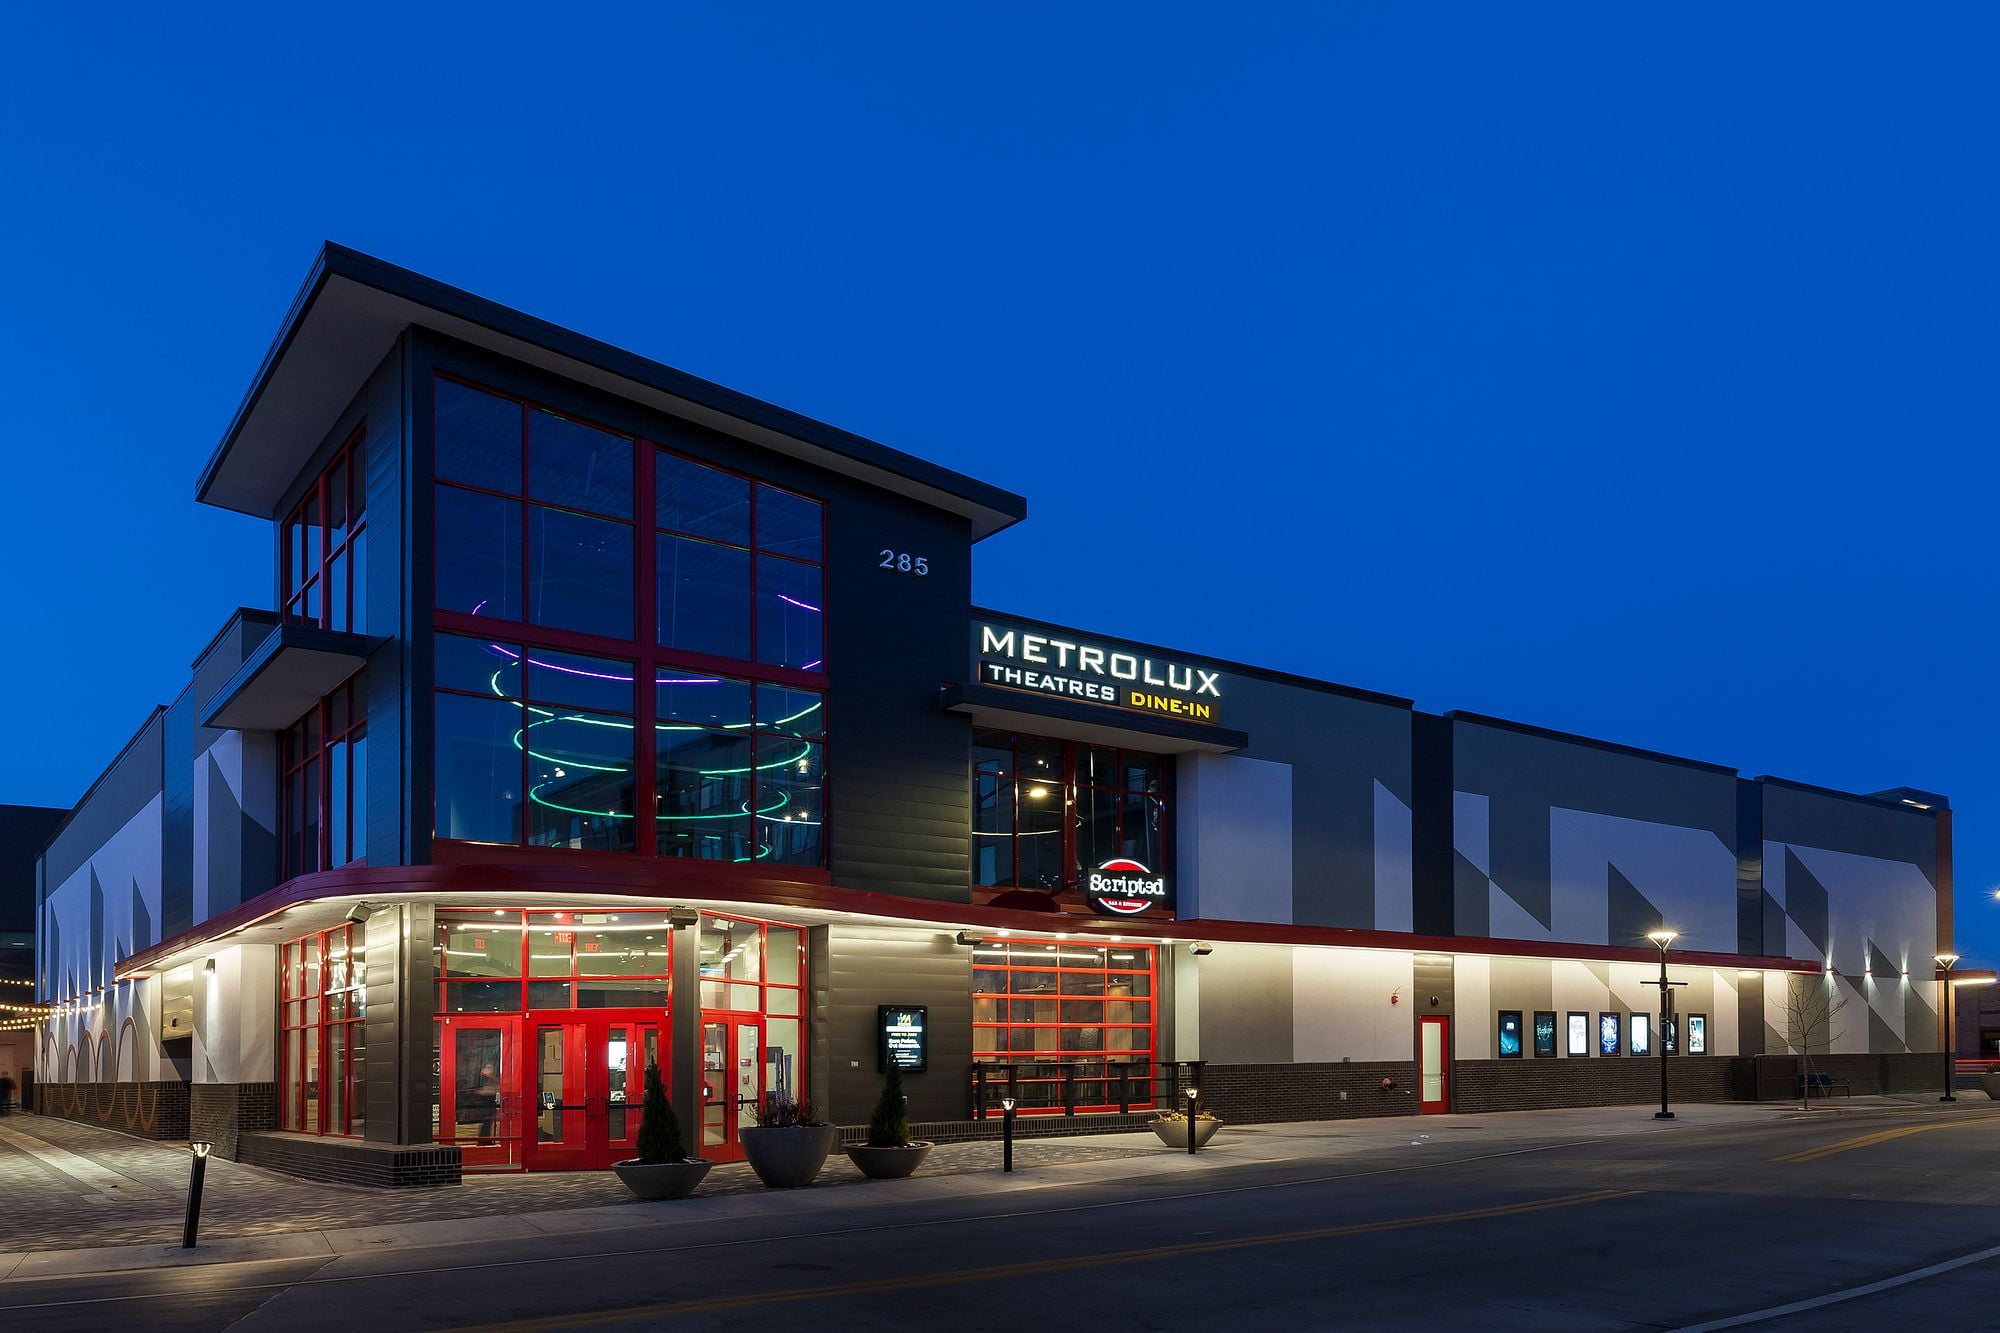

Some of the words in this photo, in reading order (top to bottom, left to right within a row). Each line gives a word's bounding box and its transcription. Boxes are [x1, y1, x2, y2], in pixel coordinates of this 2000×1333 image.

[879, 549, 929, 576] 285
[982, 625, 1221, 697] METROLUX
[988, 664, 1115, 701] THEATRES
[1131, 691, 1210, 719] DINE-IN
[1090, 874, 1165, 897] Scripted
